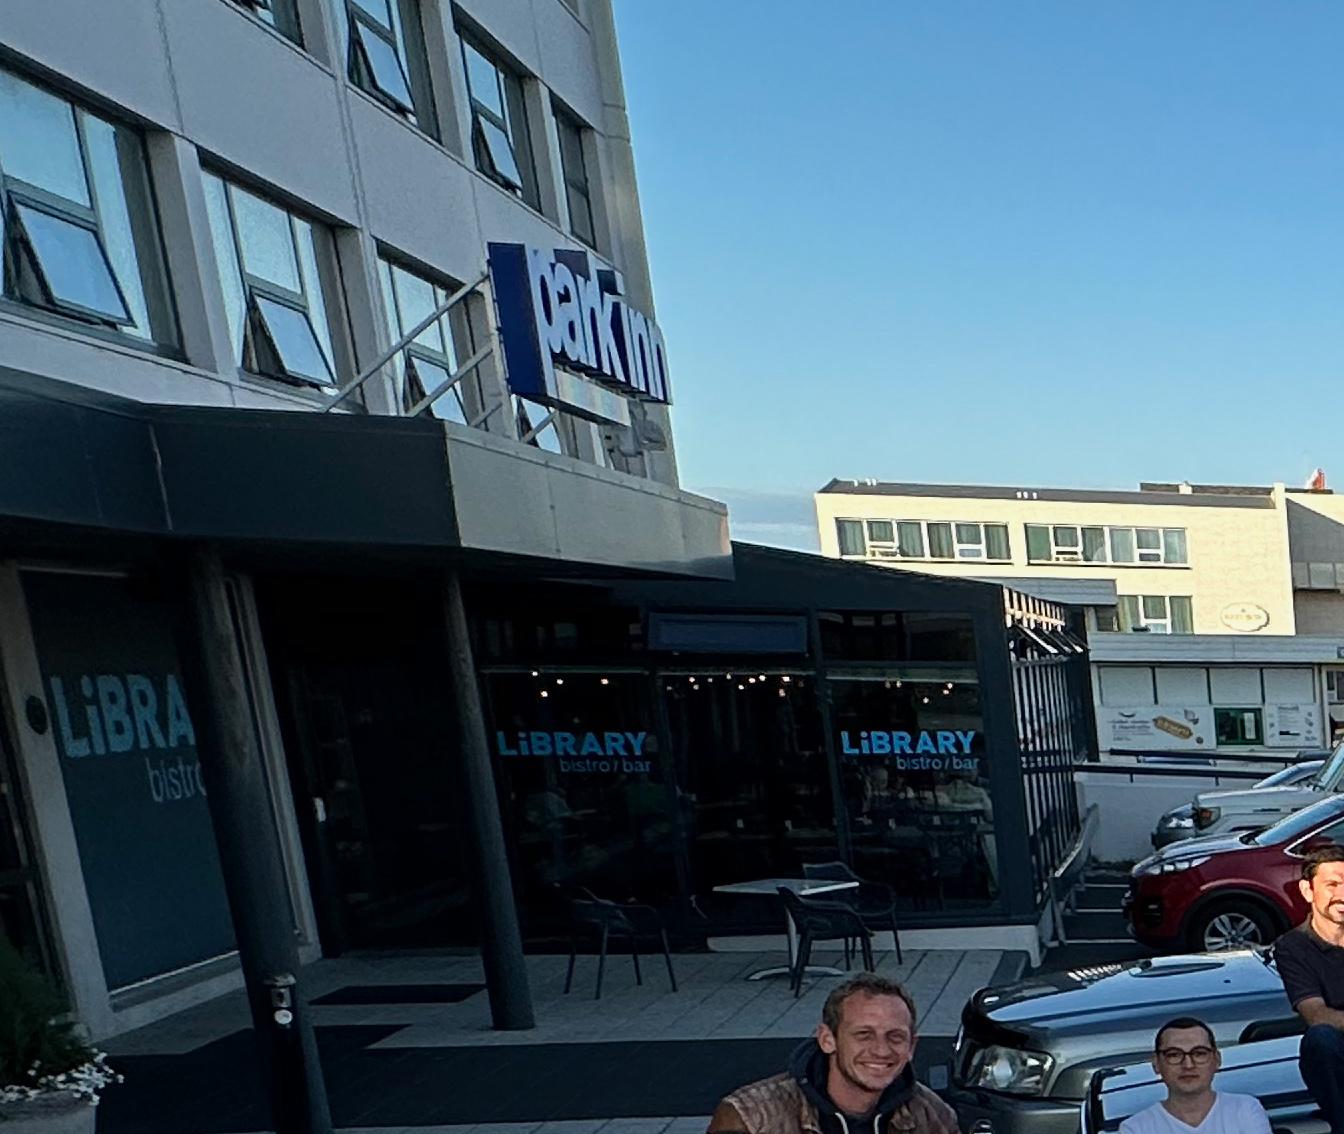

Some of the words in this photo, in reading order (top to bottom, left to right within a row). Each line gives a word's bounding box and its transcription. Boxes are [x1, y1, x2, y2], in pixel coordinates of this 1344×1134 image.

[526, 247, 627, 399] park
[615, 271, 674, 405] inn
[51, 674, 196, 758] LiBRA
